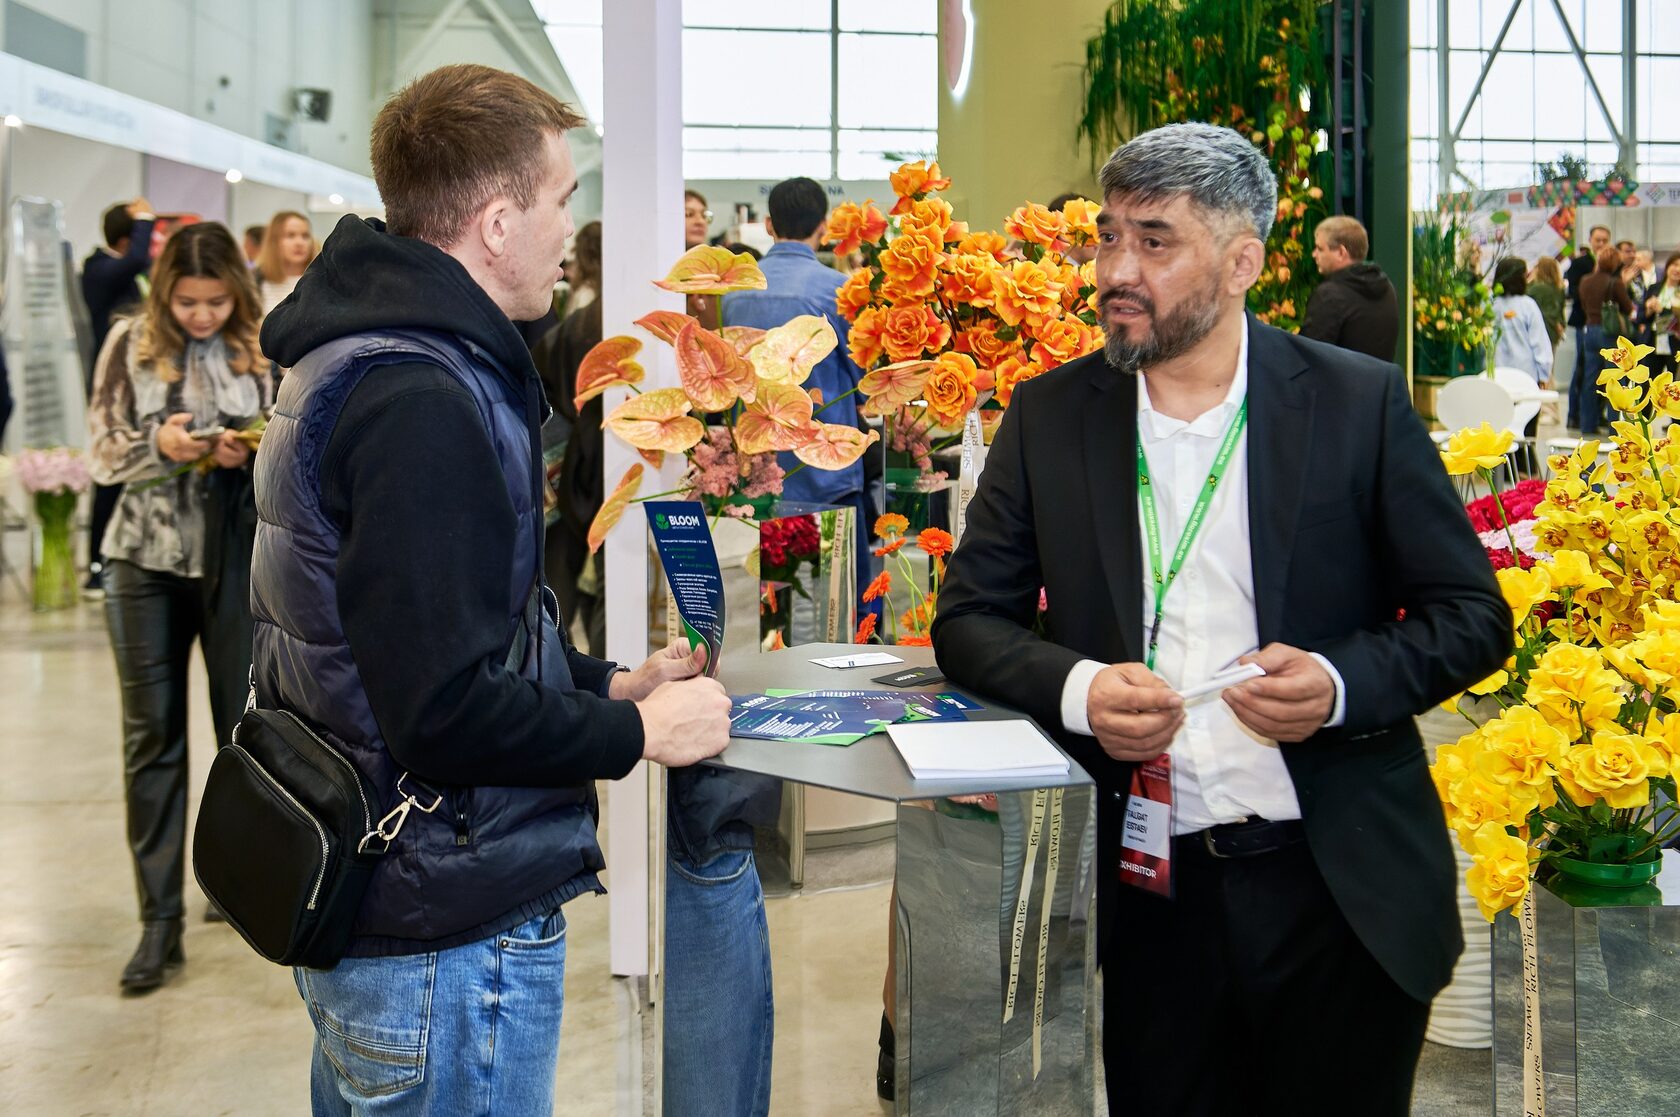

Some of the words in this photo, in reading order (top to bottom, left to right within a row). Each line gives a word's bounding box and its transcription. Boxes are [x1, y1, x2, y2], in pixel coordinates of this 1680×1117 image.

[668, 515, 700, 526] BLOOM
[1120, 860, 1157, 879] XHIBITOR
[1523, 890, 1535, 947] FLOWE
[1529, 954, 1538, 993] RICH
